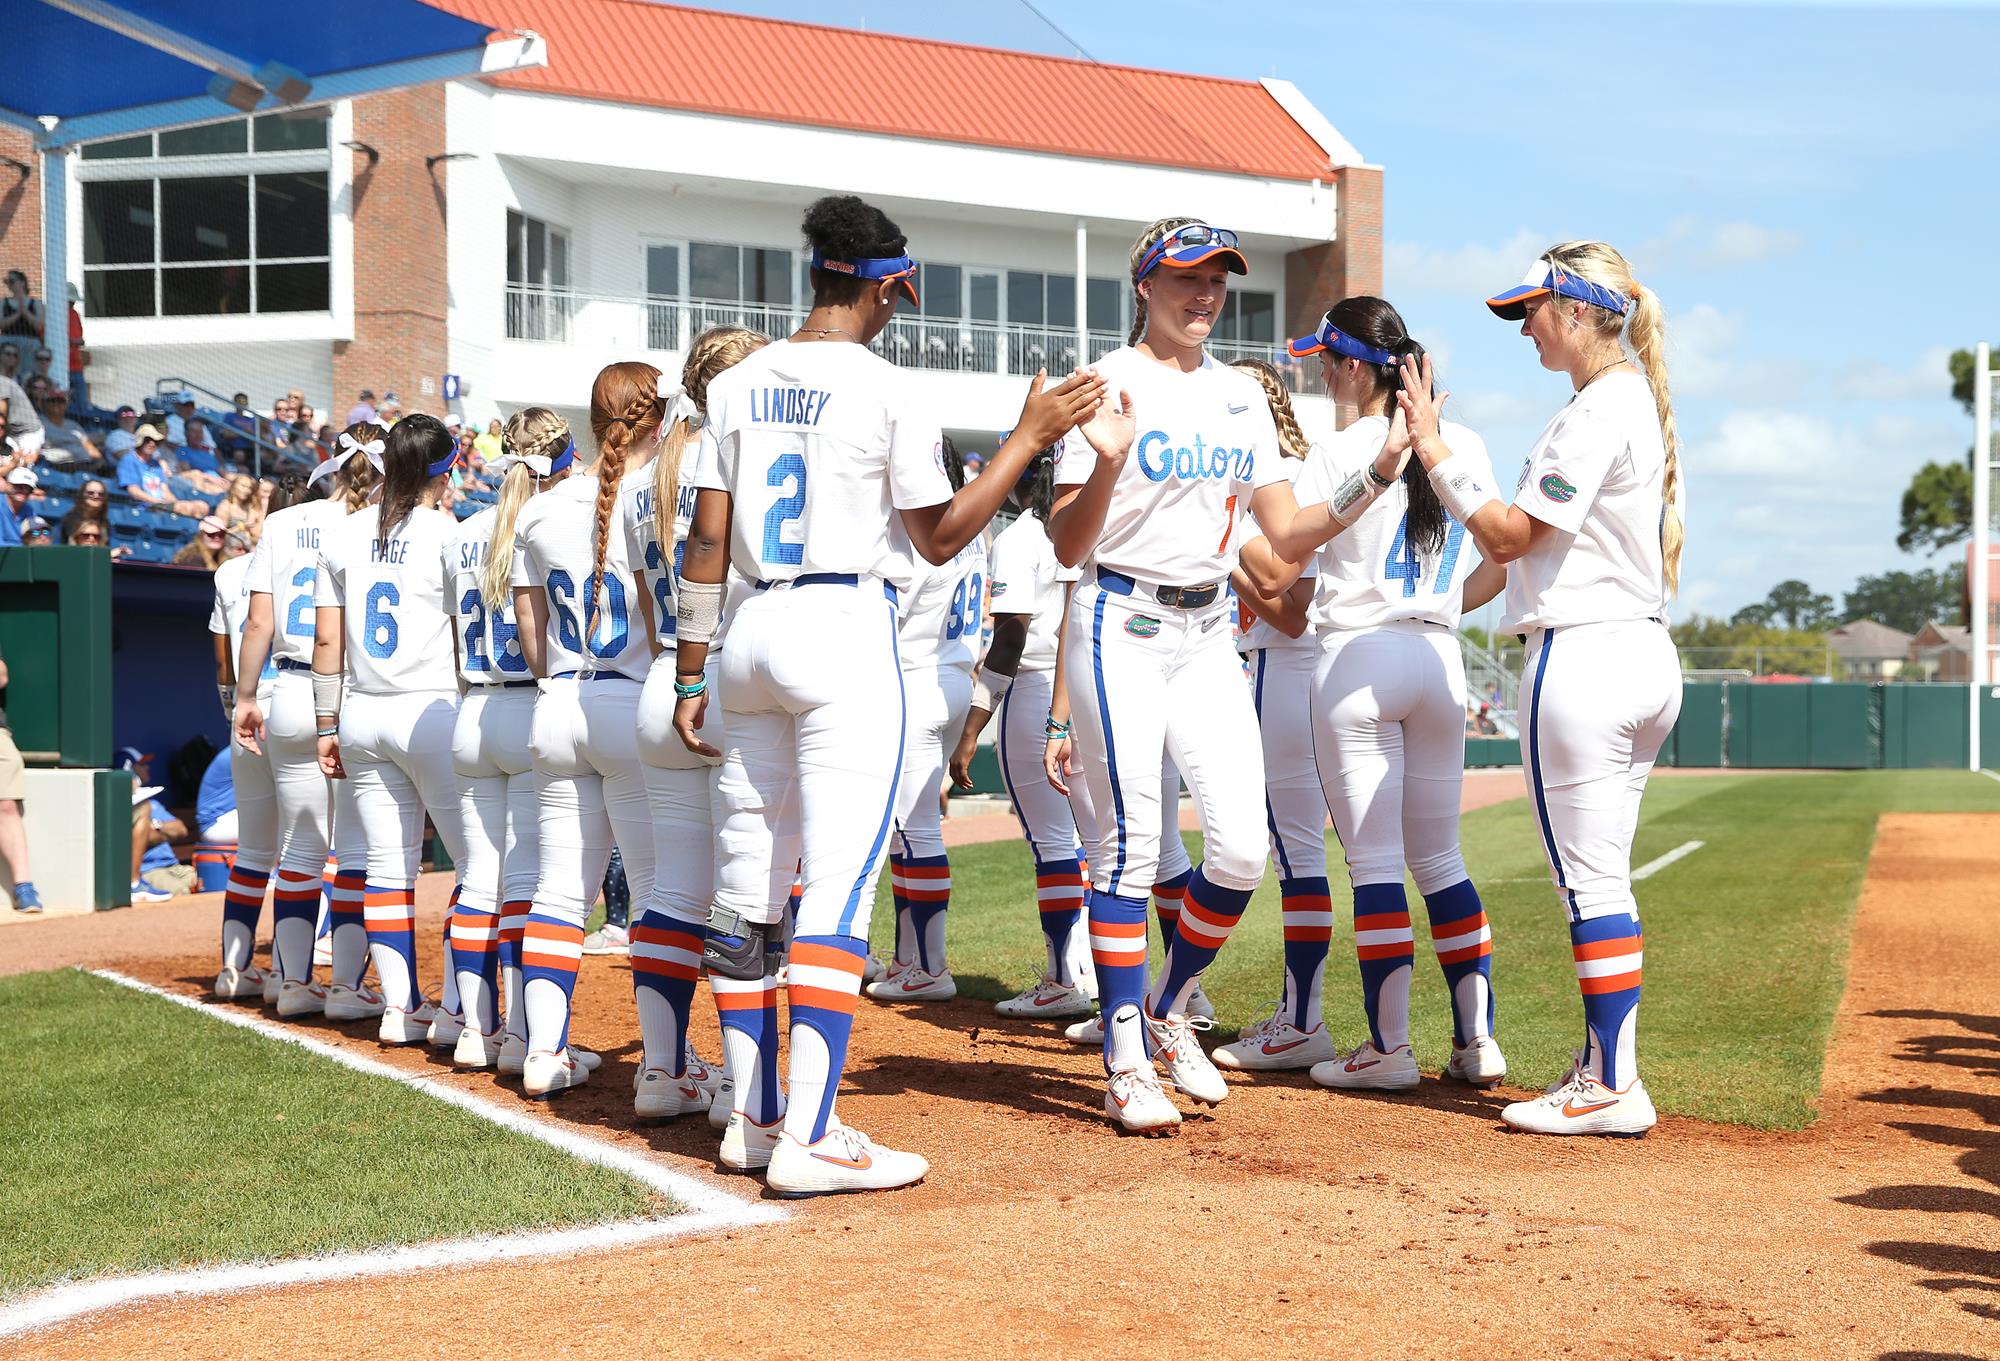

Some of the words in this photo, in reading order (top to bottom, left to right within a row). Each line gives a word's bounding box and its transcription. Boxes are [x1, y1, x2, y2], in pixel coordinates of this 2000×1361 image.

[750, 388, 832, 426] LINDSEY
[1138, 430, 1255, 482] Gators
[762, 454, 807, 566] 2
[371, 538, 410, 565] PAGE
[1384, 506, 1467, 598] 47
[363, 581, 401, 659] 6
[546, 569, 629, 659] 60
[946, 572, 983, 641] 99
